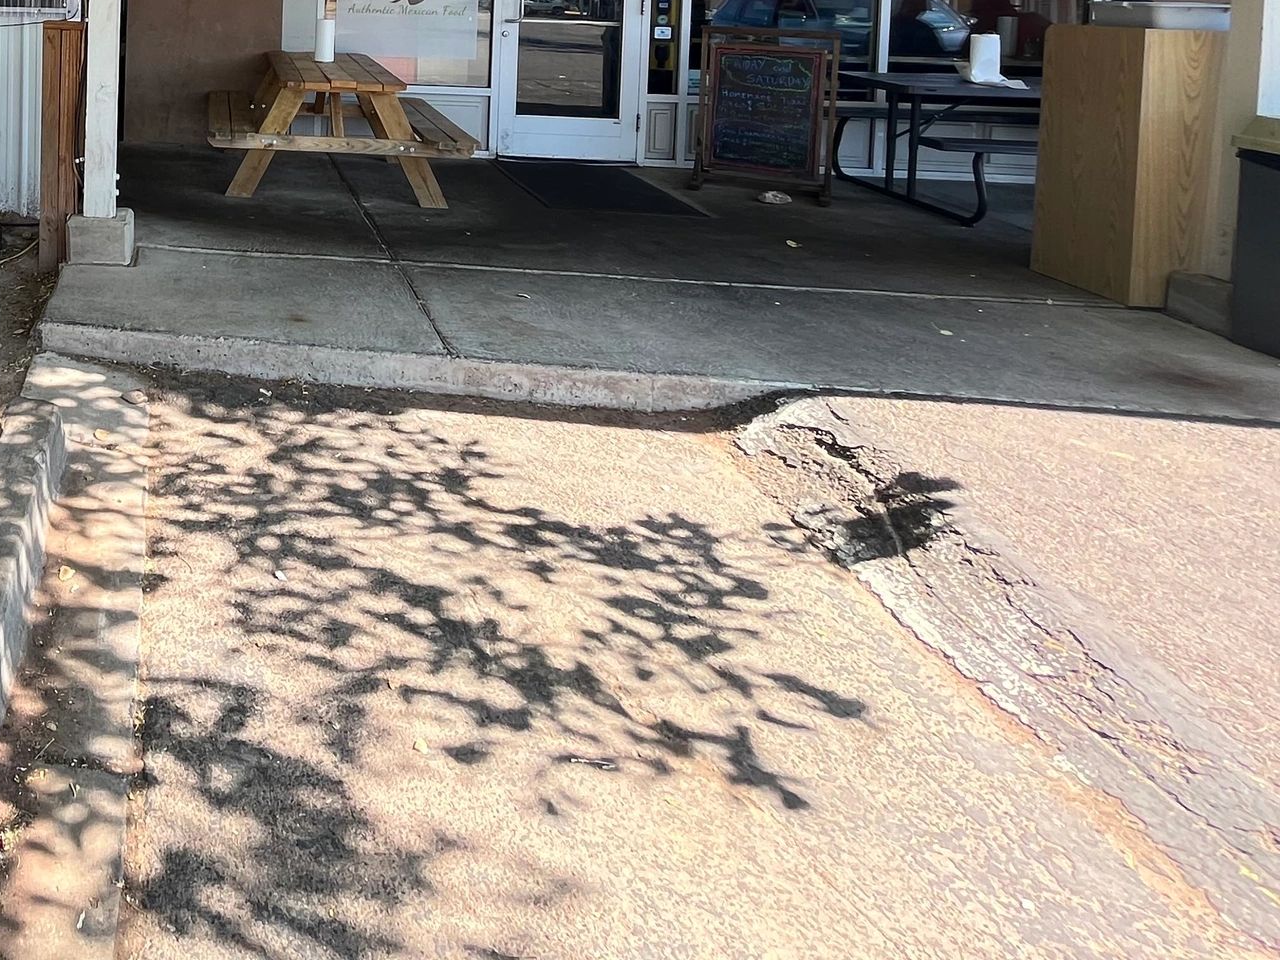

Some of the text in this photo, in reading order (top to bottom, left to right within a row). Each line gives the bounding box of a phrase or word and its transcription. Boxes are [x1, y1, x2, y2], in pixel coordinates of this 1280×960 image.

[347, 2, 467, 16] Authentic Mexican Food
